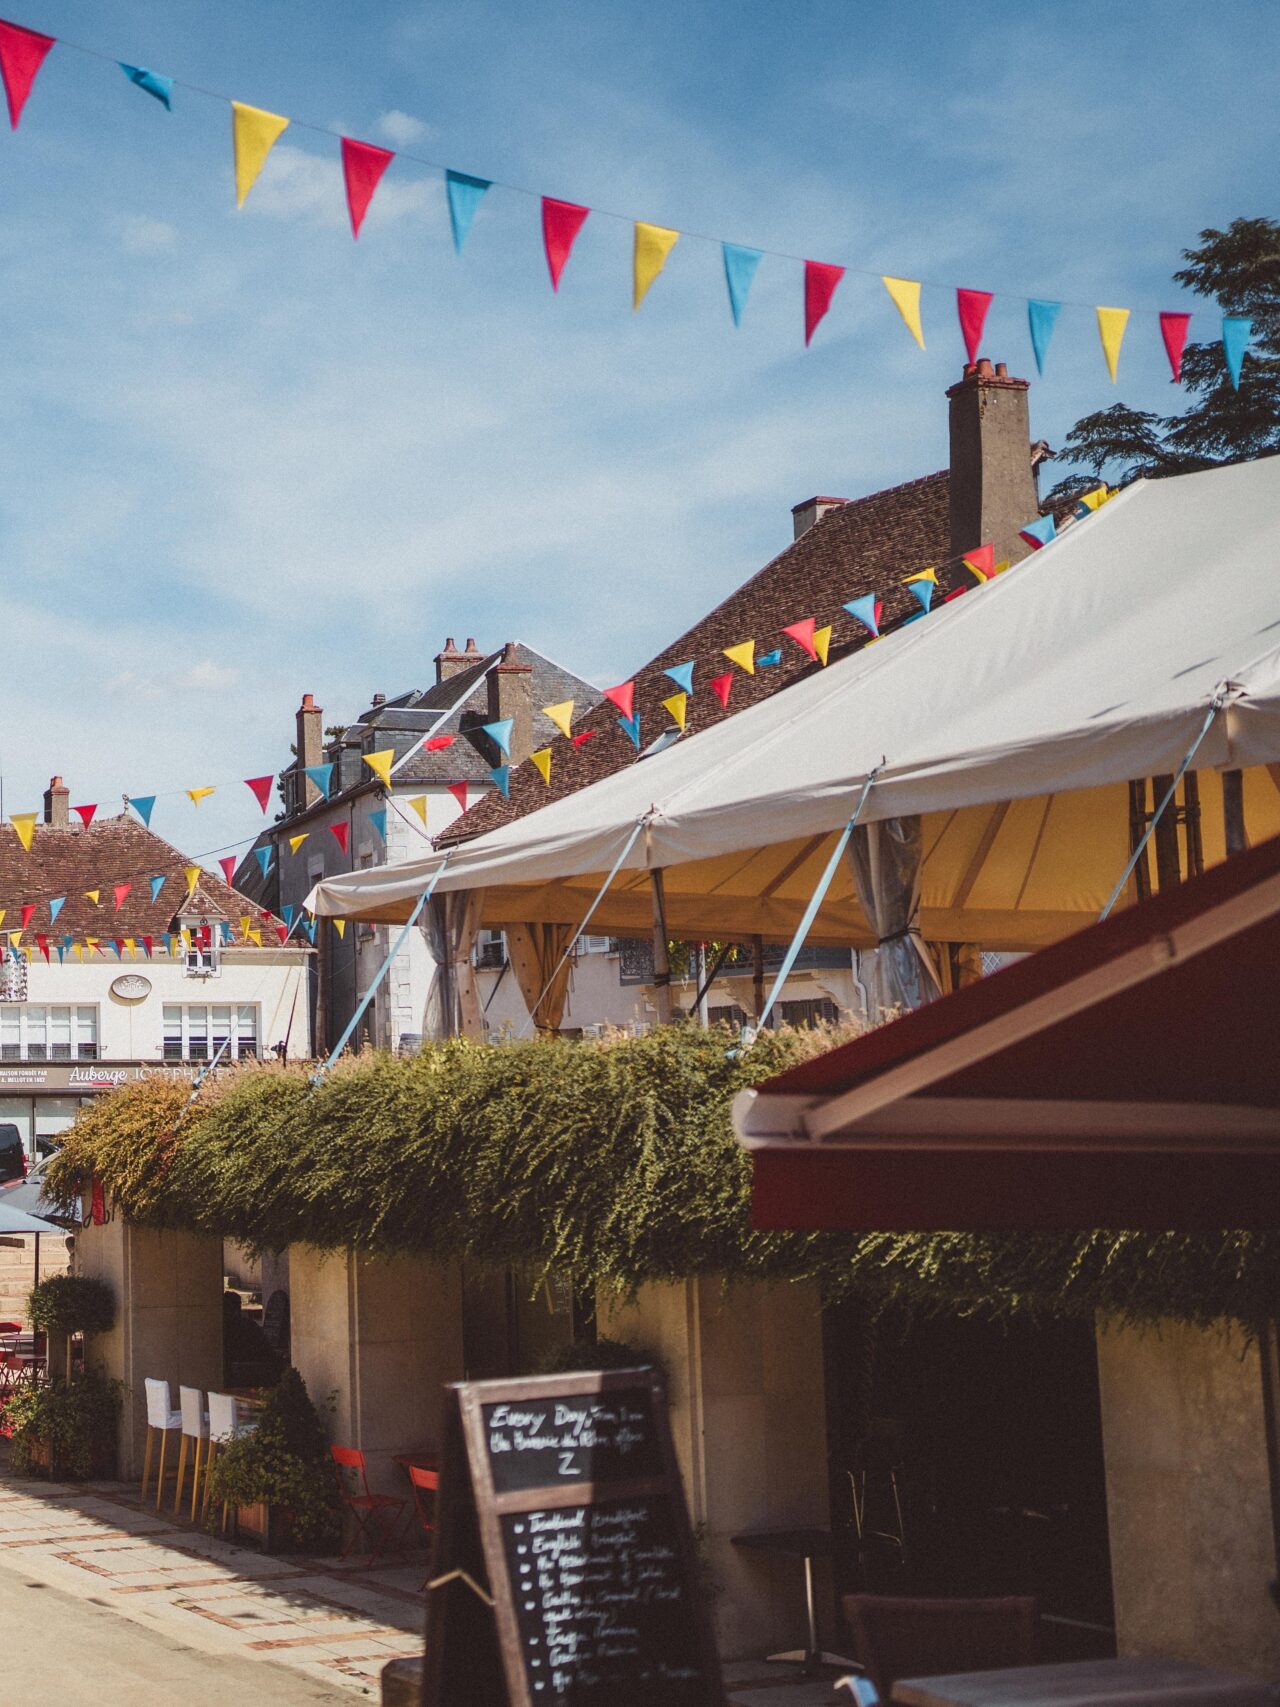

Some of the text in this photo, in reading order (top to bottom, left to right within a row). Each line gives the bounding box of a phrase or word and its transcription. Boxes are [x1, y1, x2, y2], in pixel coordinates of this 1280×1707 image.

[69, 1066, 128, 1085] Auberge
[489, 1404, 547, 1436] Every
[532, 1532, 582, 1560] English
